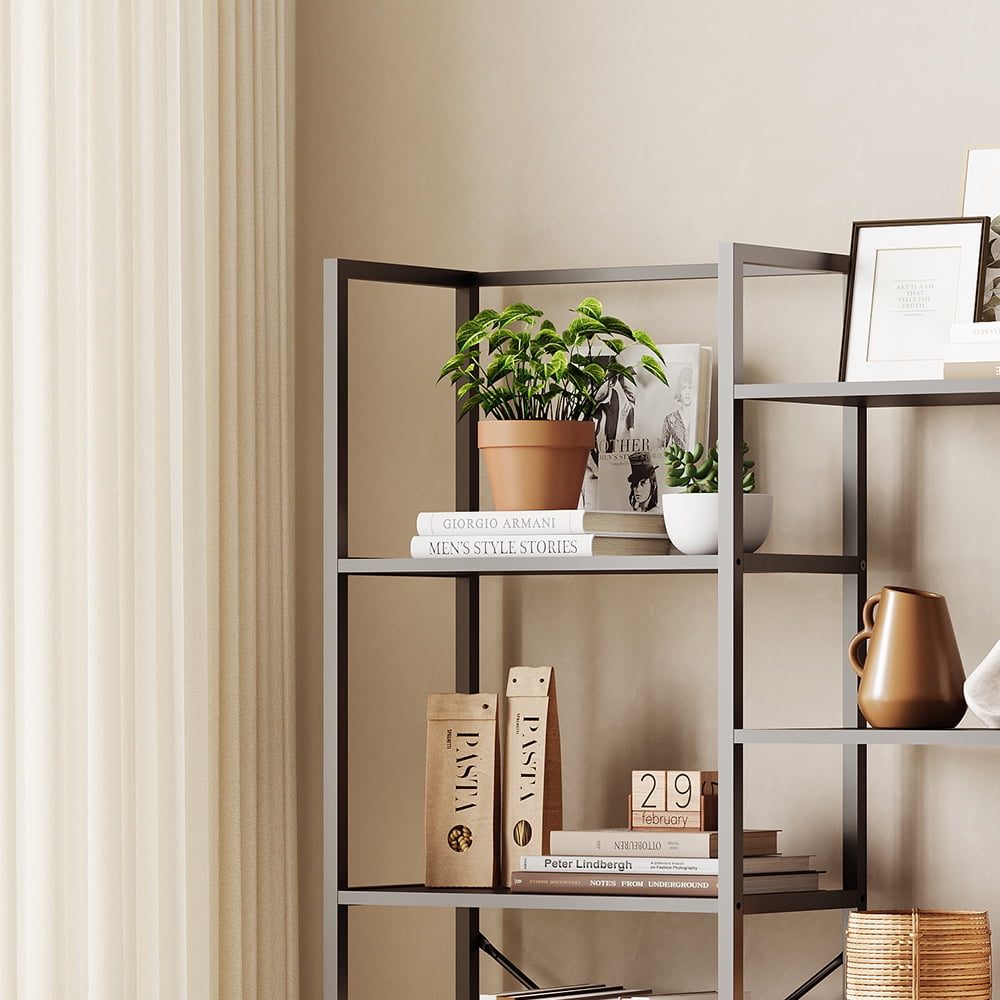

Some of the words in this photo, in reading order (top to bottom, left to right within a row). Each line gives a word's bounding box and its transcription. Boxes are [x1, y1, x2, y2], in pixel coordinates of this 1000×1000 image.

[443, 518, 498, 530] GIORGIO
[502, 518, 556, 529] ARMANI
[429, 541, 470, 556] MEN'S
[474, 540, 517, 555] STYLE
[520, 540, 578, 554] STORIES
[520, 717, 540, 802] PASTA
[455, 732, 479, 812] PASTA
[642, 811, 688, 828] february
[614, 841, 662, 850] OTTOBEUREN
[544, 858, 573, 869] Peter
[576, 859, 632, 872] Lindbergh
[590, 879, 616, 887] NOTES
[621, 880, 644, 888] FROM
[648, 880, 709, 889] UNDERGROUND
